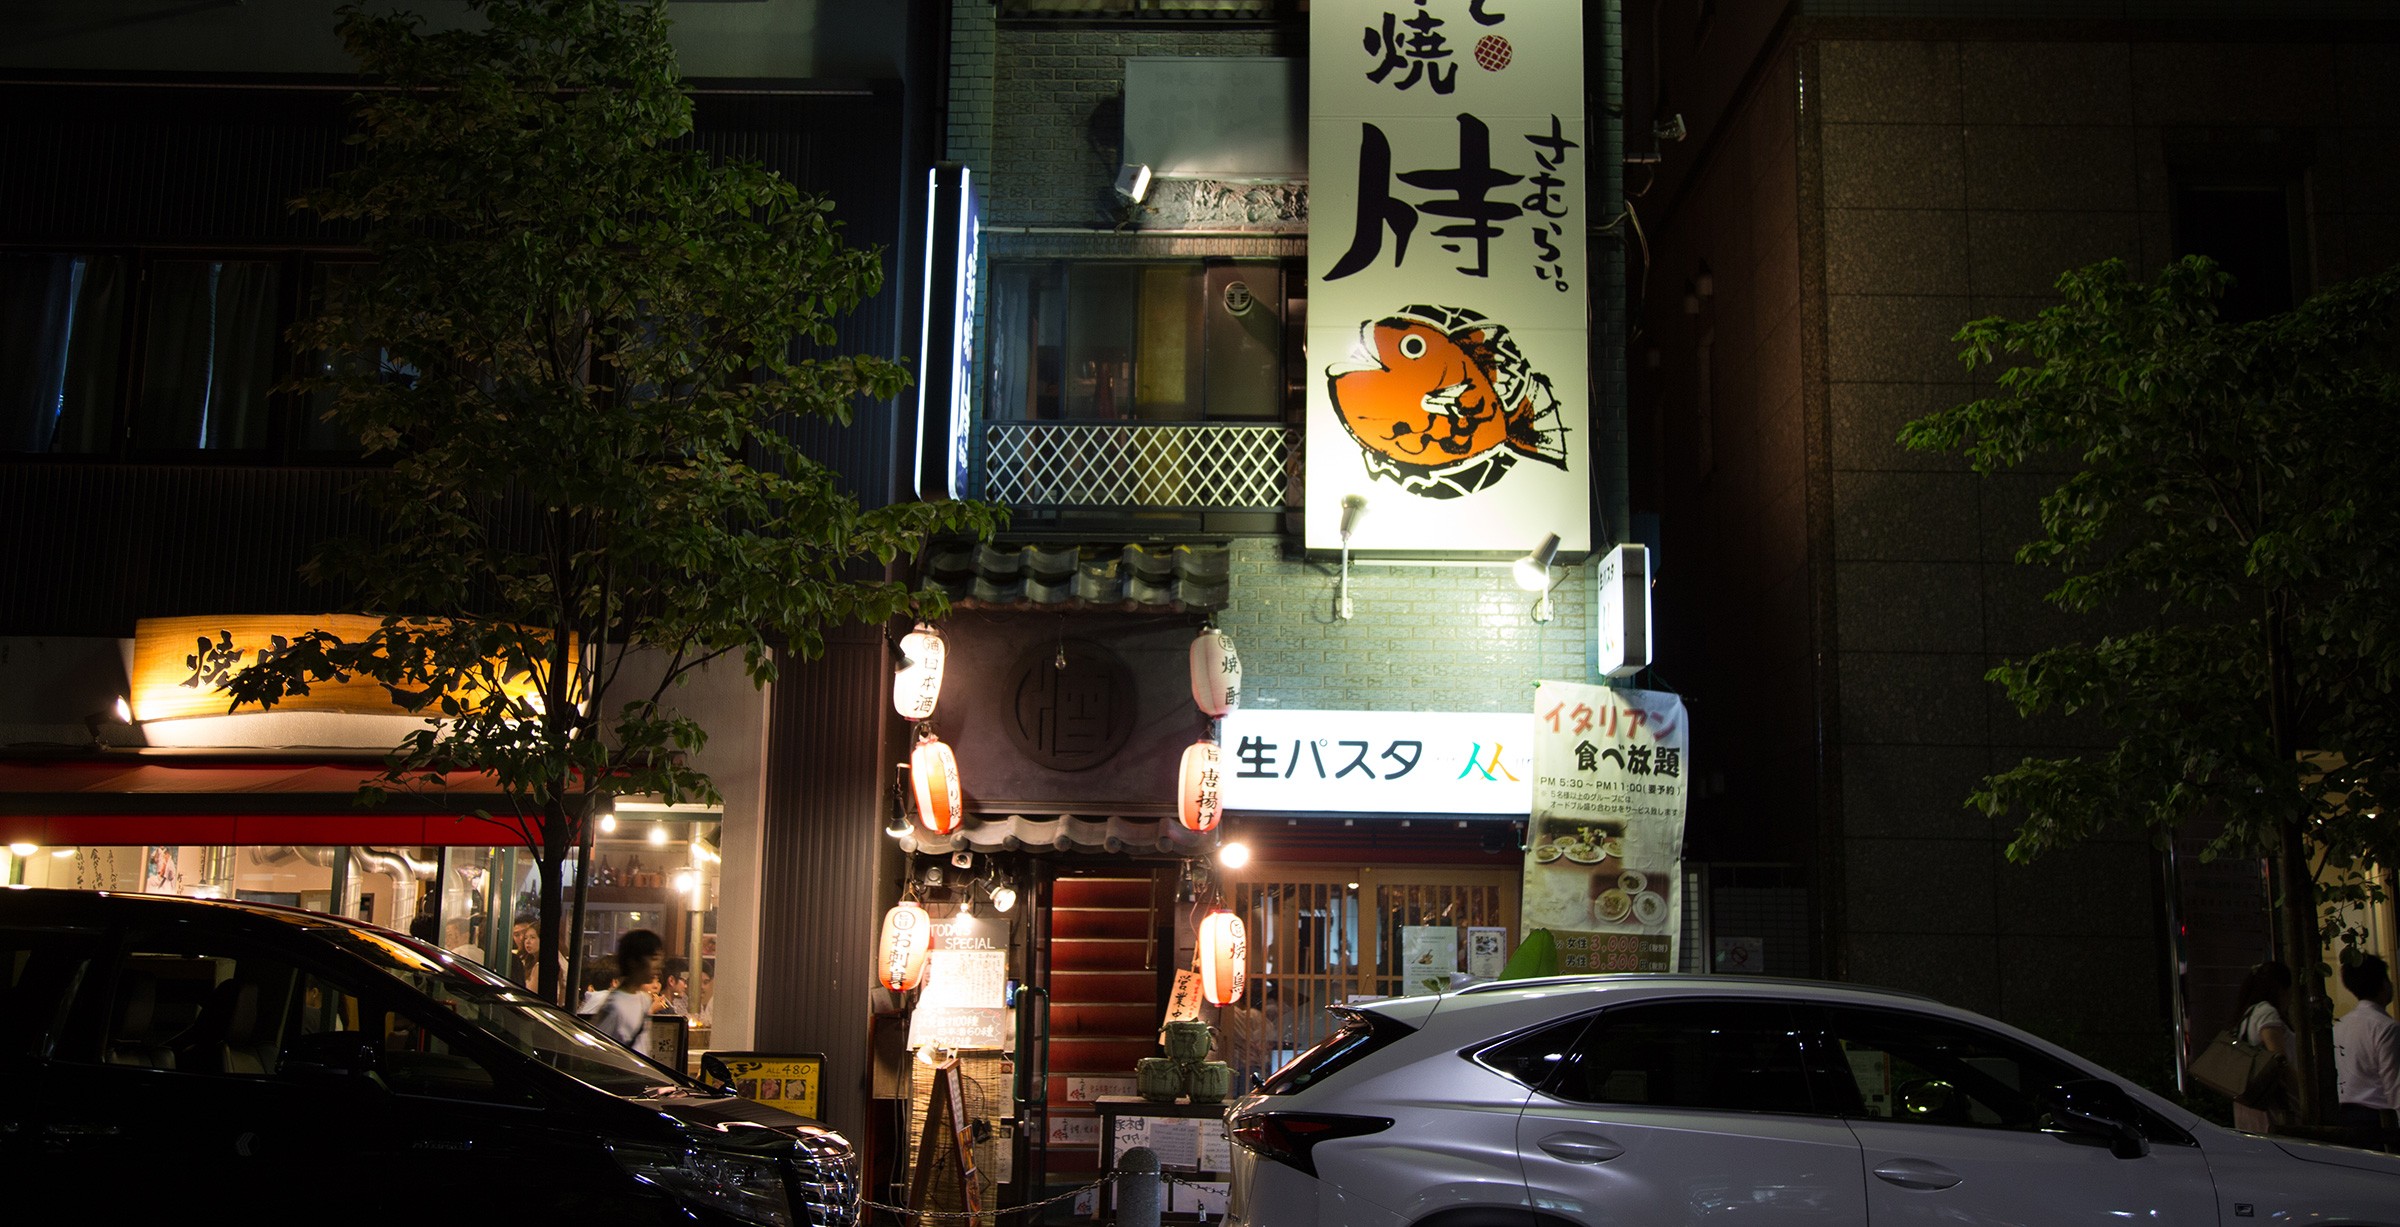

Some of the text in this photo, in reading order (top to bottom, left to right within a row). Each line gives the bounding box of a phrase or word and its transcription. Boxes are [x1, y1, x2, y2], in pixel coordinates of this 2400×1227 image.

[1363, 0, 1458, 95] 焼
[1322, 112, 1526, 282] 侍
[914, 657, 938, 713] 日本酒
[1545, 703, 1676, 741] イタリアン
[1236, 735, 1423, 781] 生パスタ
[1574, 739, 1681, 779] 食べ放題
[1195, 768, 1221, 827] 唐揚げ
[886, 932, 912, 988] お刺身
[945, 937, 996, 950] SPECIAL
